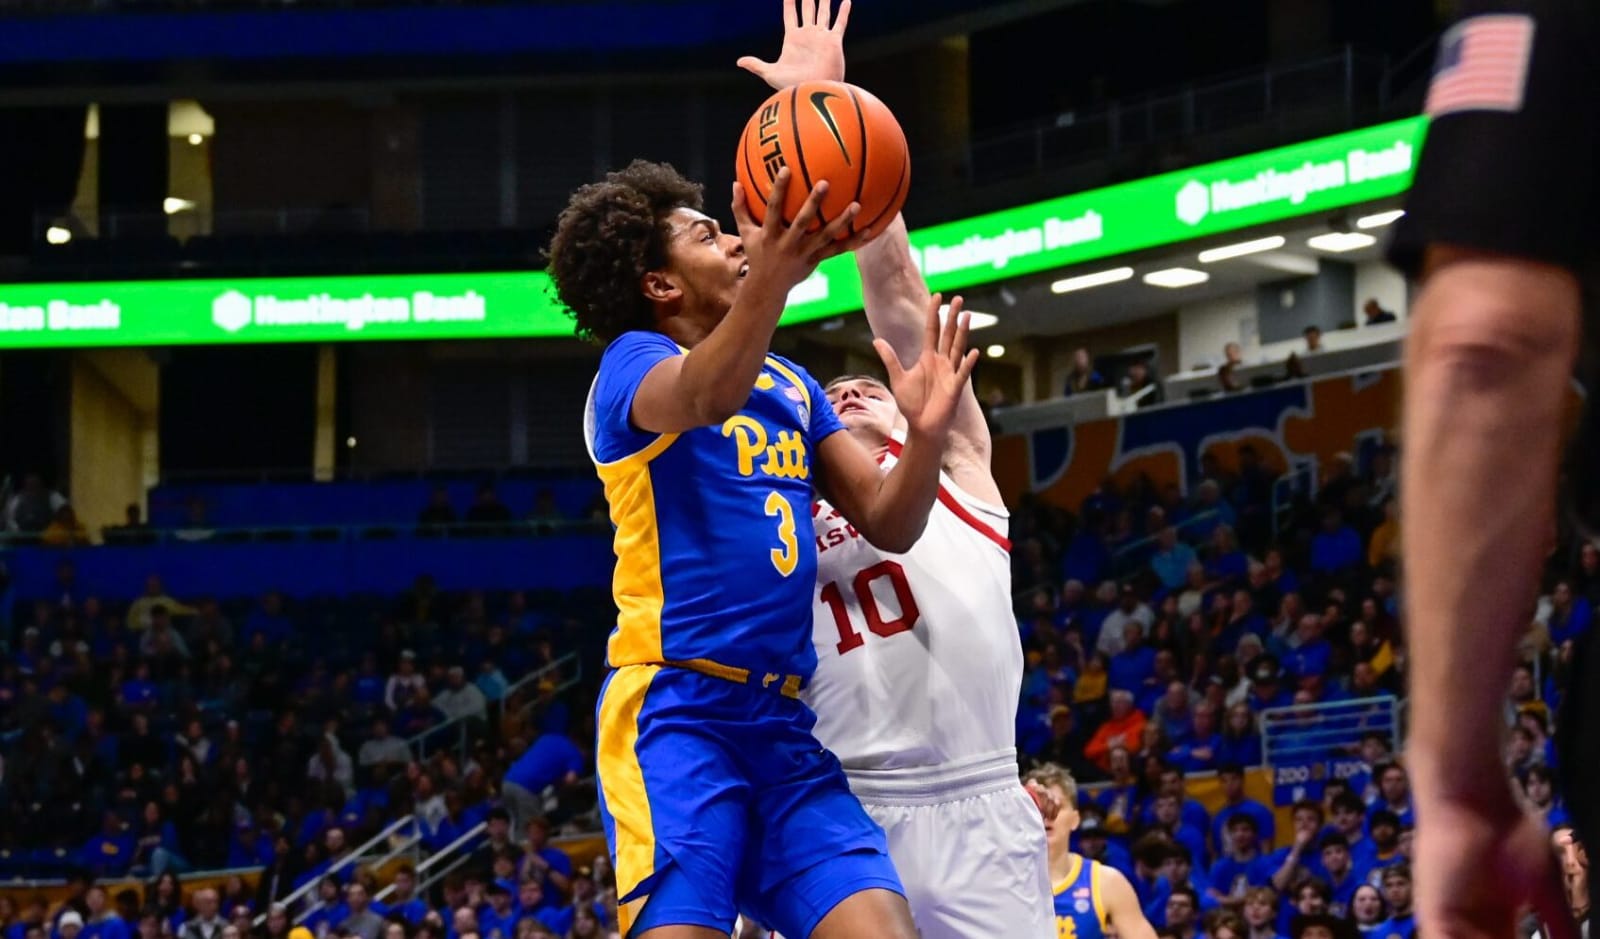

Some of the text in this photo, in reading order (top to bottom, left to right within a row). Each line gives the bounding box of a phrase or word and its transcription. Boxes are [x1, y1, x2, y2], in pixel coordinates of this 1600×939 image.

[759, 101, 788, 185] ELITE
[1210, 141, 1412, 213] Huntington Bank
[924, 210, 1102, 276] Huntington Bank
[47, 299, 120, 330] Bank
[254, 290, 485, 330] Huntington Bank
[721, 415, 808, 480] Pitt
[764, 490, 799, 578] 3
[820, 559, 920, 655] 10
